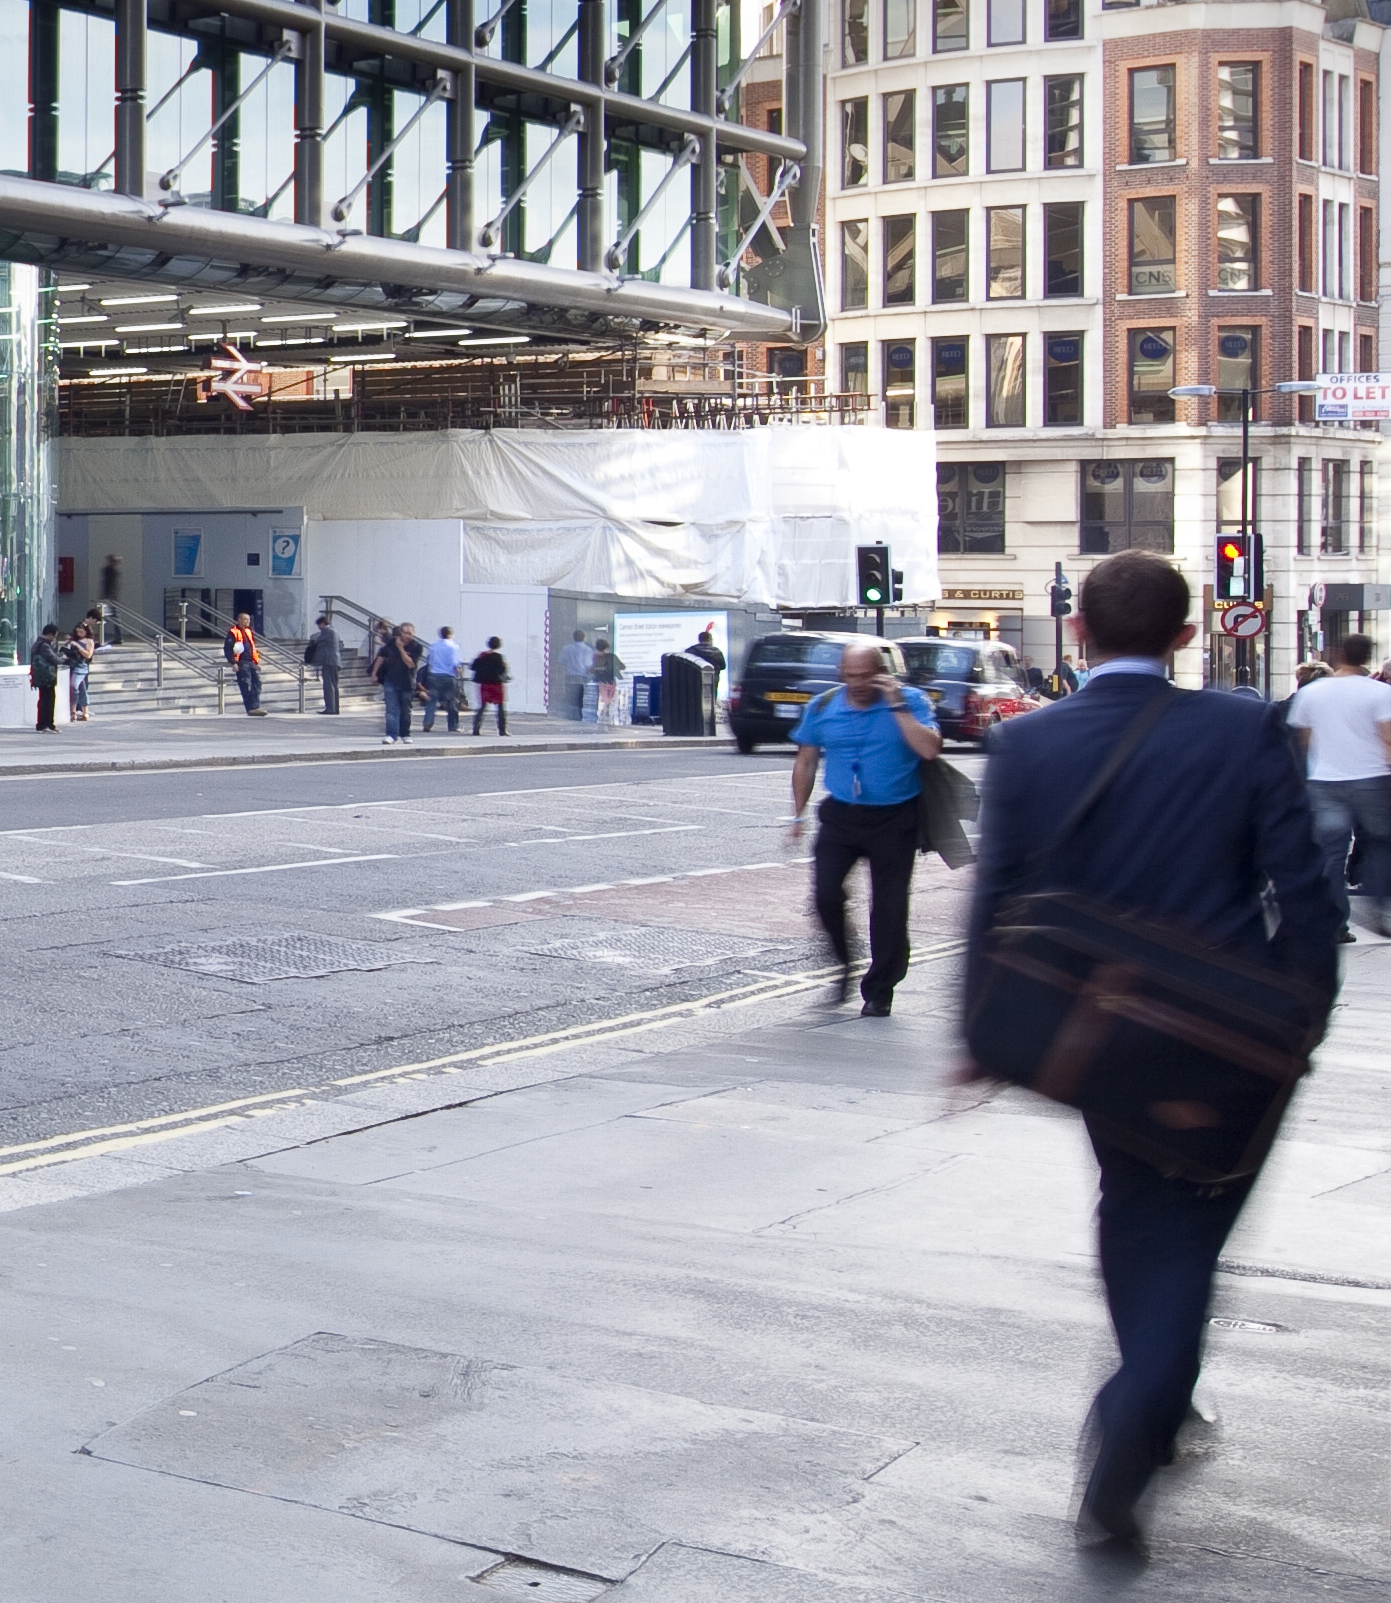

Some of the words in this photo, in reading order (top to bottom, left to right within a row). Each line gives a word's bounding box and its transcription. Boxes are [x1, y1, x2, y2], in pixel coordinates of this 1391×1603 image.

[1329, 375, 1379, 384] OFFICES
[1322, 386, 1347, 401] TO
[1353, 385, 1390, 400] LET
[954, 590, 964, 598] &
[970, 590, 1023, 599] CURTIS
